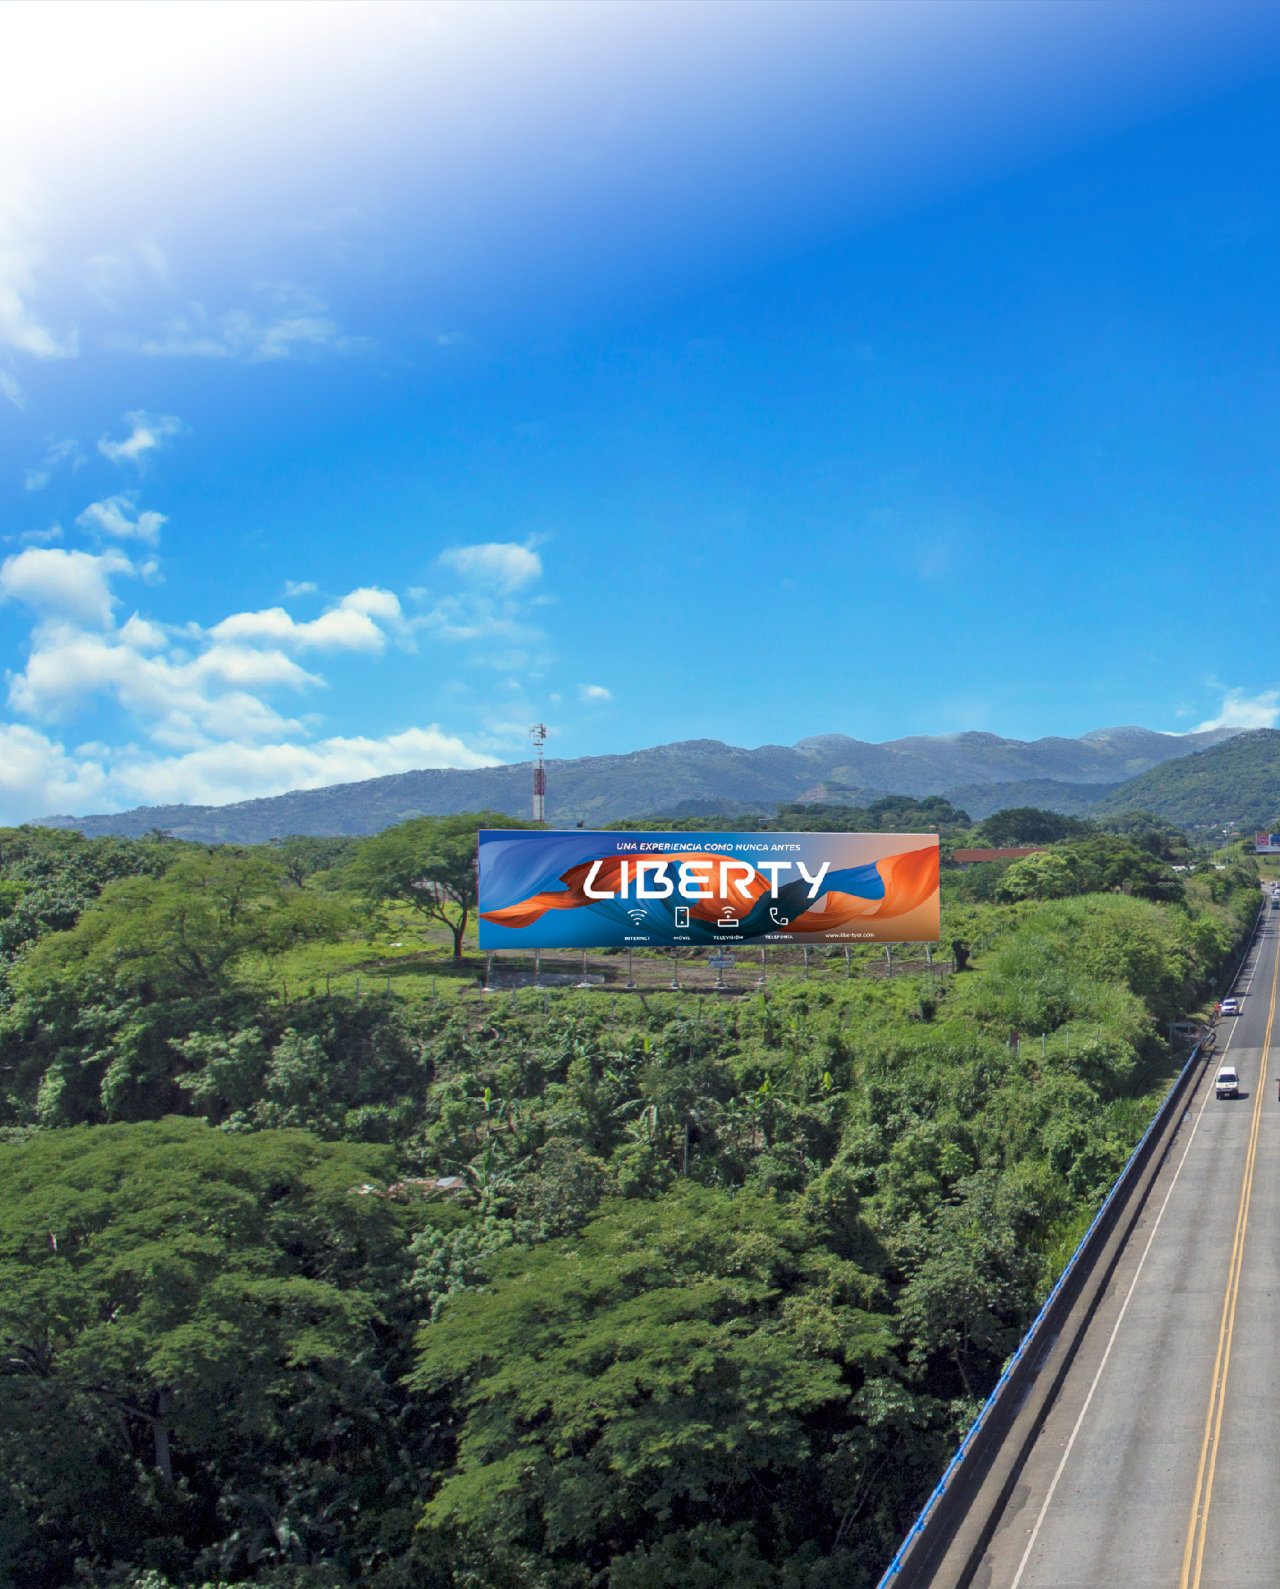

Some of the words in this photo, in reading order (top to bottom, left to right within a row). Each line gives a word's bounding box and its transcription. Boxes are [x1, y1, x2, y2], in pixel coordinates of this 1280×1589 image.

[616, 842, 638, 850] UNA
[639, 842, 702, 851] EXPERIENCIA
[704, 843, 734, 851] COMO
[735, 843, 769, 851] NUNCA
[582, 860, 831, 899] LIBERTY
